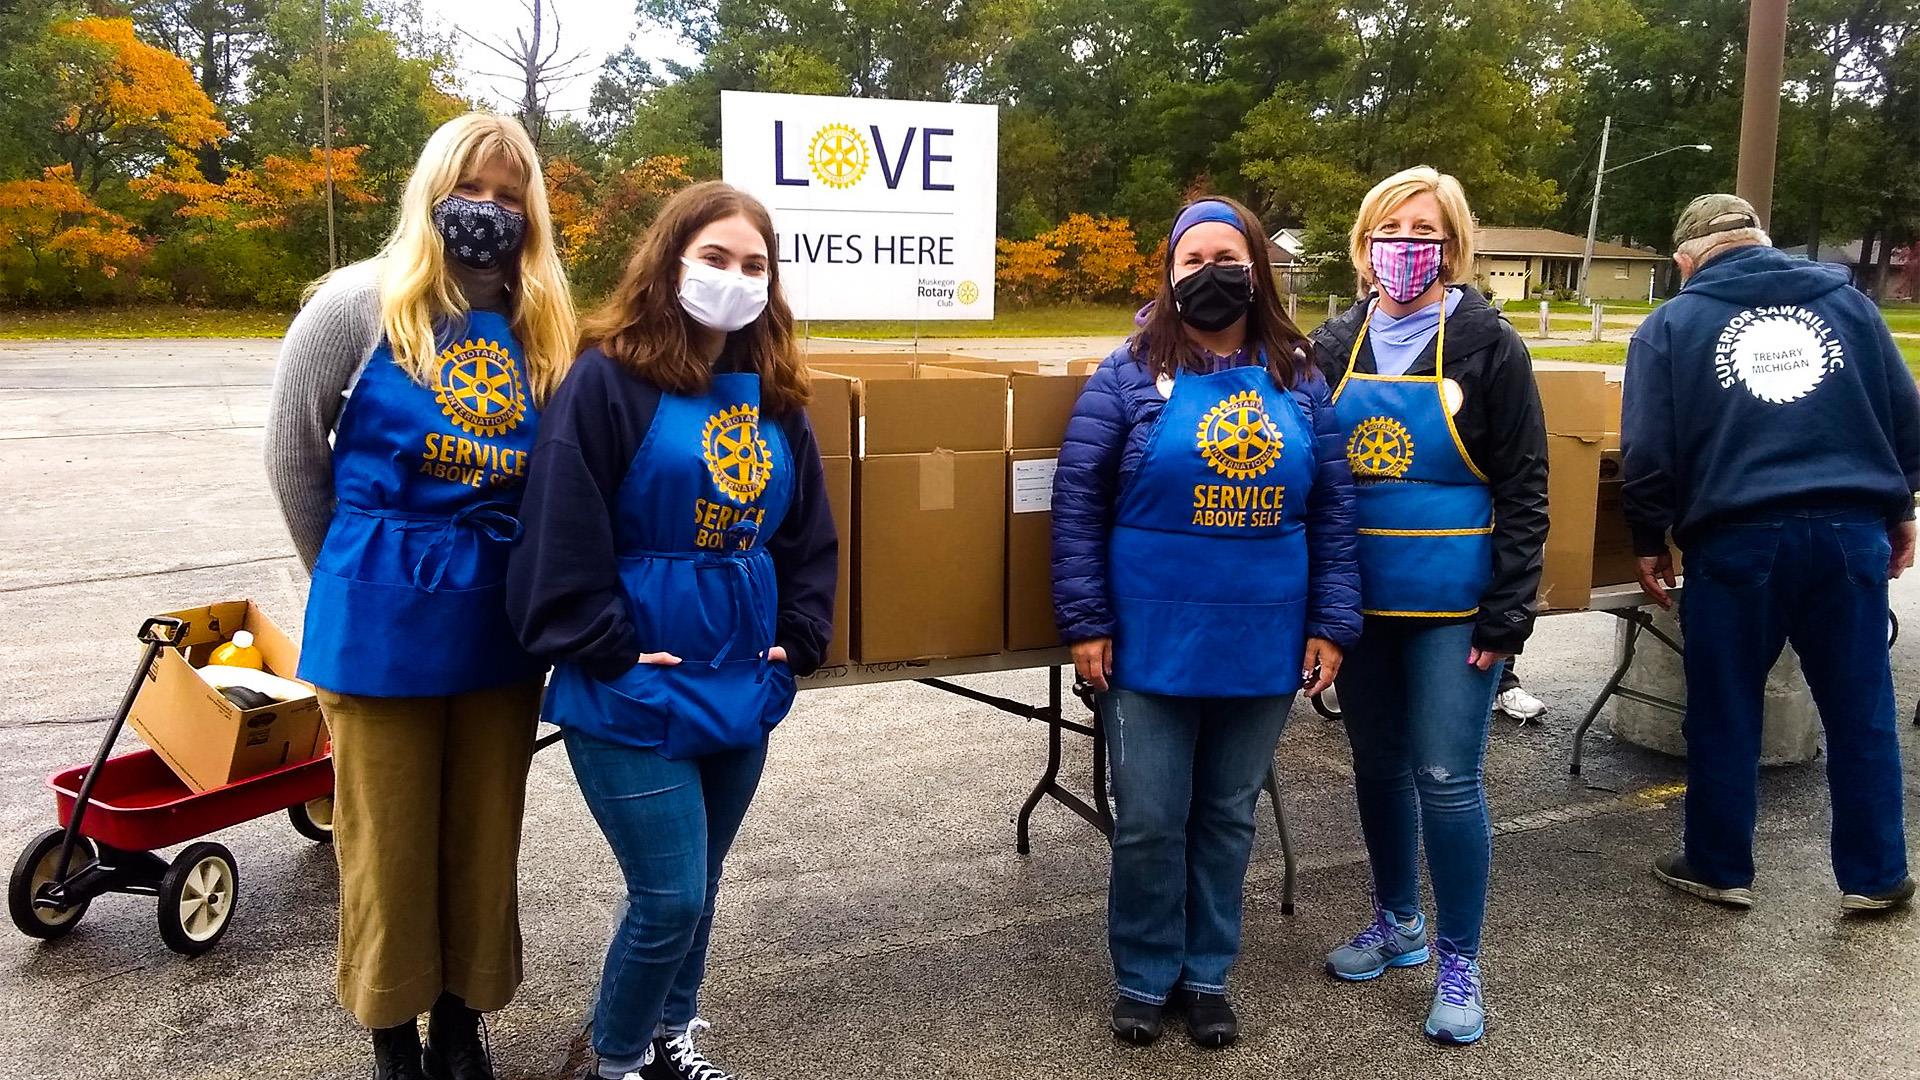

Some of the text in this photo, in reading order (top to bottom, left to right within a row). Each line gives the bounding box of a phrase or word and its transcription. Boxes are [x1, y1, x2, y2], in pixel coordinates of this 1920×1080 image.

[776, 233, 955, 266] LIVES HERE
[917, 286, 955, 299] Rotary
[918, 278, 955, 287] Muskegon
[937, 299, 954, 307] Club
[459, 350, 503, 364] ROTARY
[1715, 310, 1755, 389] SUPERIOR
[1755, 305, 1832, 339] SAWMILL
[1752, 348, 1803, 362] TRENARY
[1751, 359, 1810, 374] MICHIGAN
[446, 394, 518, 426] INTERNATIONAL
[422, 432, 528, 477] SERVICE
[1210, 447, 1274, 470] INTERNATIONAL
[419, 461, 485, 488] ABOVE
[1193, 484, 1286, 510] SERVICE
[1192, 510, 1282, 527] ABOVE SELF
